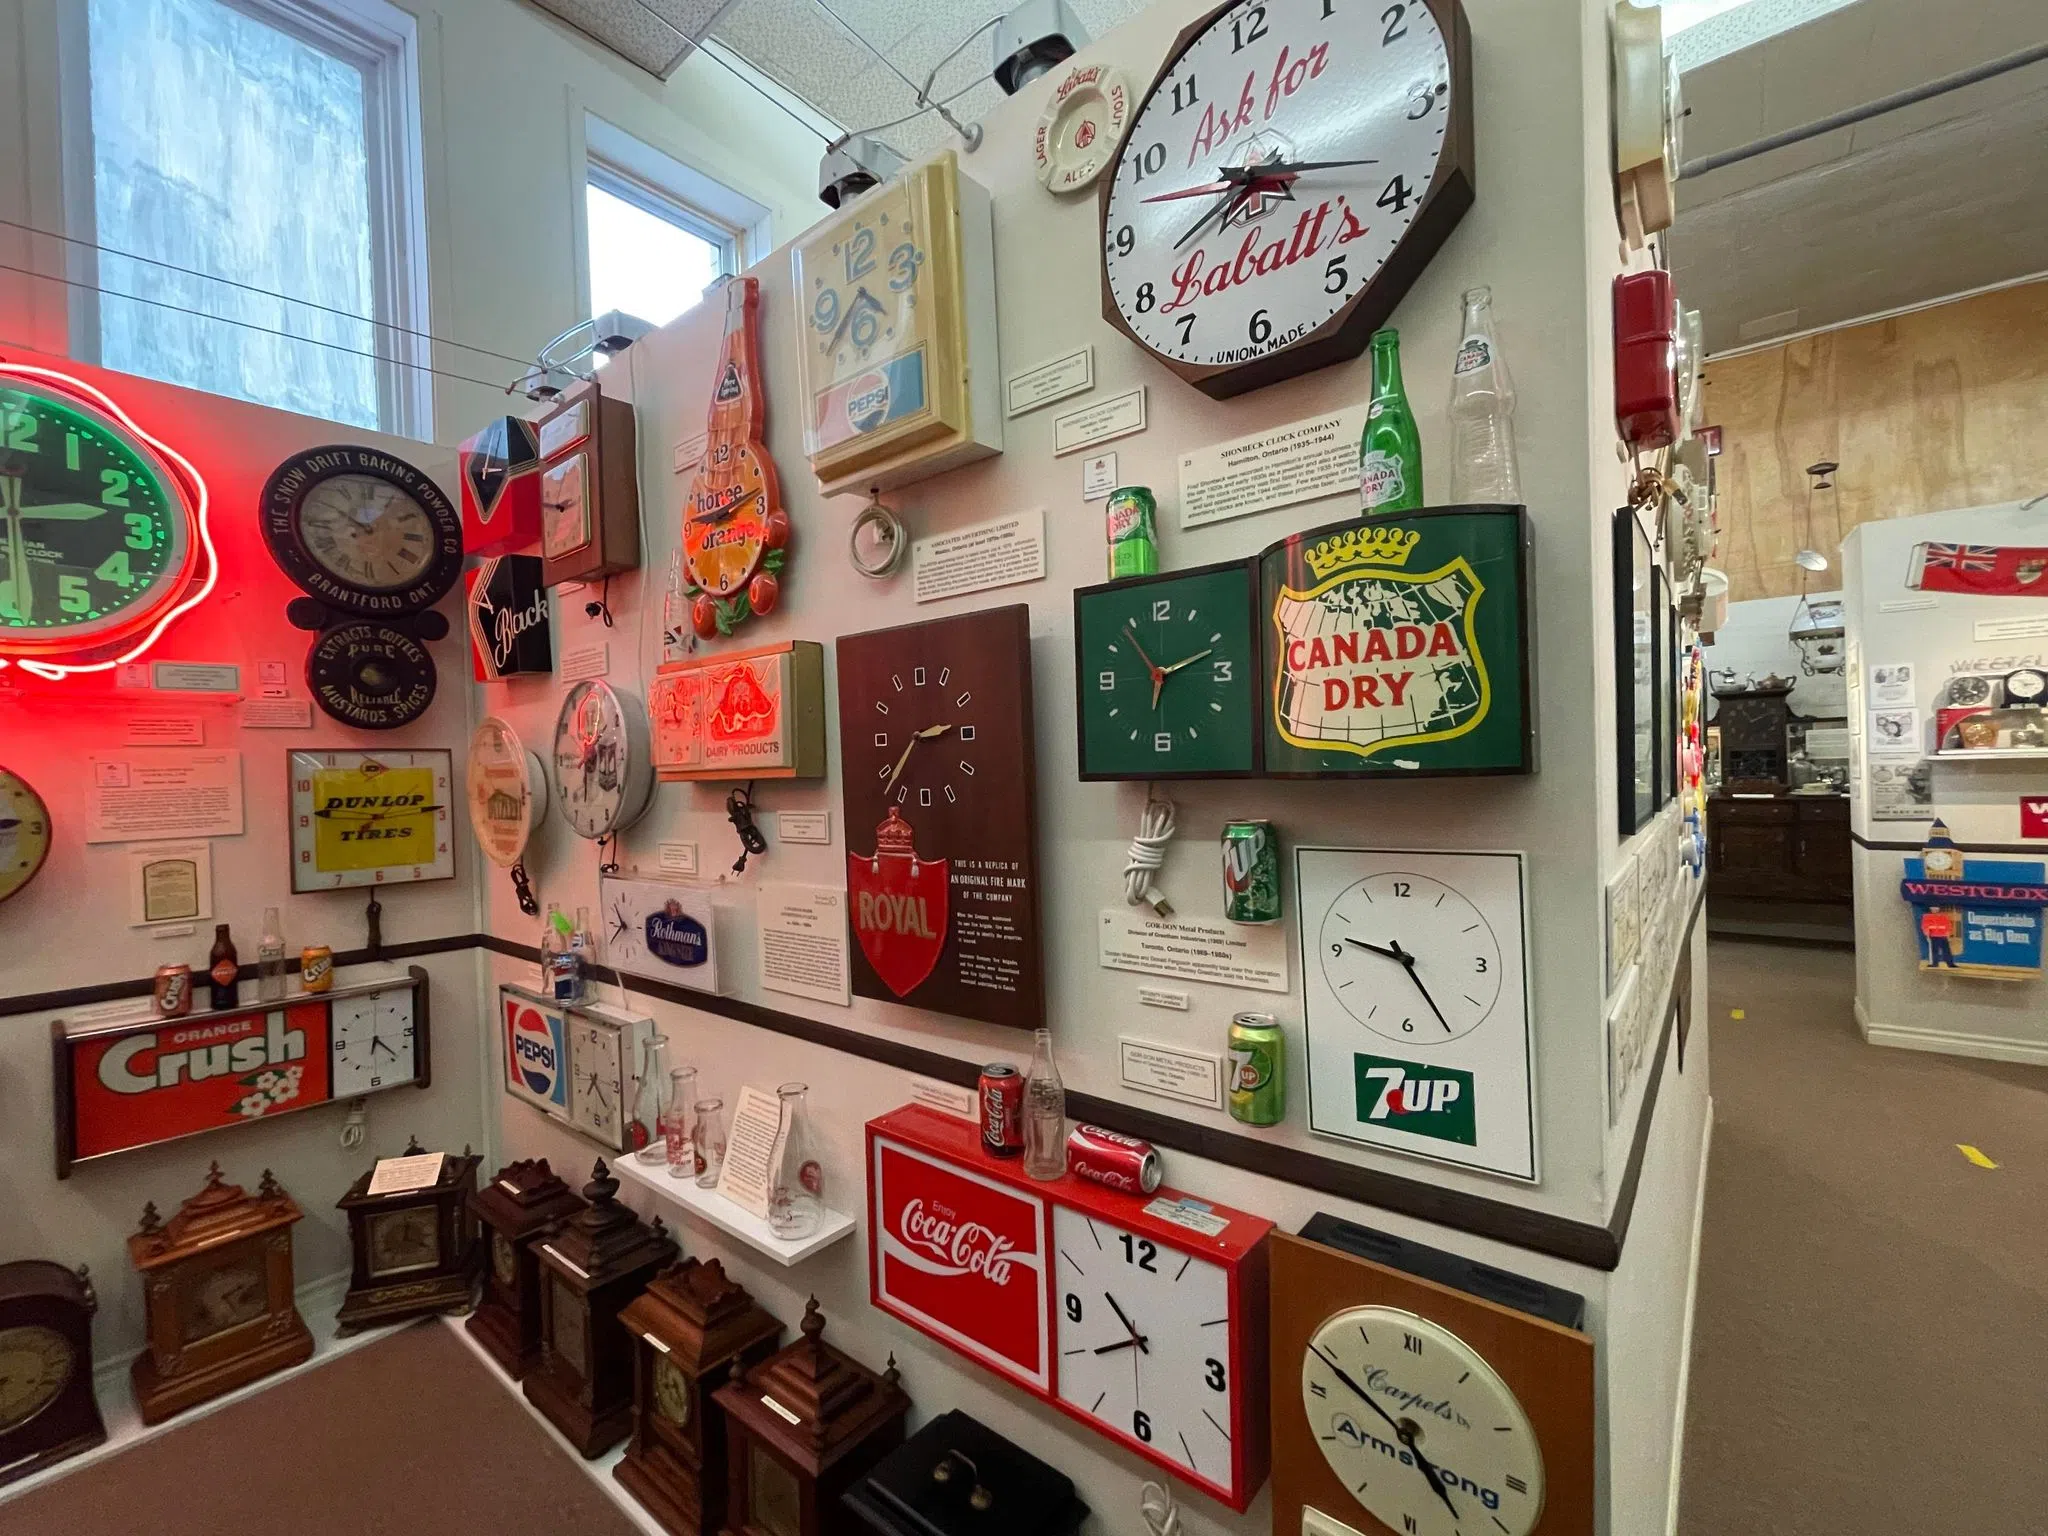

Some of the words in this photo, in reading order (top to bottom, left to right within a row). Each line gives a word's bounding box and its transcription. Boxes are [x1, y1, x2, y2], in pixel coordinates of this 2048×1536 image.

[1230, 7, 1270, 54] 12
[1381, 4, 1407, 47] 2
[1111, 85, 1124, 129] STOUT
[1171, 74, 1200, 116] 11
[1187, 70, 1256, 169] Ask
[1263, 41, 1330, 121] for
[1406, 80, 1435, 121] 3
[1036, 126, 1047, 169] LAGER
[1133, 142, 1167, 185] 10
[1064, 159, 1095, 184] ALES
[1376, 174, 1412, 214] 4
[842, 228, 876, 285] 12
[1116, 224, 1135, 257] 9
[1160, 195, 1369, 315] Labatt's
[888, 242, 917, 293] 3
[1324, 254, 1349, 294] 5
[815, 287, 840, 335] 9
[1136, 282, 1156, 314] 8
[851, 298, 878, 348] 6
[1175, 313, 1197, 346] 7
[1248, 309, 1272, 344] 6
[1216, 345, 1258, 365] UNION
[1267, 325, 1308, 353] MADE
[848, 386, 889, 417] PEPSI
[66, 433, 80, 471] 1
[714, 444, 729, 465] 12
[1221, 441, 1264, 459] SHONBECK
[1266, 432, 1296, 446] CLOCK
[1297, 419, 1342, 437] COMPANY
[1262, 446, 1288, 458] Ontario
[305, 451, 352, 474] DRIFT
[359, 453, 416, 484] BAKING
[101, 468, 129, 507] 2
[274, 467, 307, 504] SNOW
[1365, 481, 1385, 494] DRY
[416, 482, 455, 532] POWDER
[756, 495, 765, 515] 3
[124, 513, 152, 550] 3
[272, 509, 289, 535] THE
[684, 521, 692, 538] 9
[94, 551, 134, 587] 4
[720, 574, 728, 591] 6
[59, 575, 90, 613] 5
[308, 572, 402, 609] BRANTFORD
[1152, 601, 1171, 621] 12
[495, 588, 549, 668] Black
[379, 628, 424, 663] COFFEES
[1287, 621, 1460, 673] CANADA
[1100, 671, 1114, 691] 9
[1213, 662, 1232, 682] 3
[393, 683, 428, 719] SPICES
[1323, 671, 1416, 712] DRY
[706, 745, 728, 758] DAIRY
[732, 742, 779, 757] PRODUCTS
[1155, 733, 1172, 752] 6
[297, 780, 310, 792] 10
[439, 777, 446, 788] 2
[326, 795, 424, 809] DUNLOP
[300, 815, 309, 828] 9
[340, 827, 412, 841] TIRES
[301, 851, 310, 863] 8
[438, 843, 447, 853] 4
[954, 859, 966, 868] THIS
[978, 860, 982, 868] A
[985, 861, 1008, 870] REPLICA
[336, 874, 343, 886] 7
[376, 870, 384, 882] 6
[414, 867, 421, 878] 5
[951, 875, 959, 884] AN
[960, 875, 988, 886] ORIGINAL
[990, 876, 1003, 887] FIRE
[1007, 878, 1026, 888] MARK
[973, 892, 982, 900] THE
[986, 893, 1013, 903] COMPANY
[1393, 883, 1411, 898] 12
[1905, 883, 2048, 901] WESTCLOX
[650, 917, 702, 946] Rothmans
[858, 891, 937, 940] ROYAL
[1332, 943, 1342, 957] 9
[1476, 957, 1487, 973] 3
[174, 1020, 253, 1045] ORANGE
[1402, 1018, 1414, 1033] 6
[98, 1011, 305, 1093] Crush
[515, 1034, 555, 1071] PEPSI
[932, 1200, 957, 1221] Enjoy
[900, 1198, 1014, 1287] Coca-Cola
[1118, 1233, 1158, 1274] 12
[1065, 1293, 1083, 1323] 9
[1404, 1332, 1423, 1356] XII
[1205, 1357, 1226, 1393] 3
[1362, 1364, 1452, 1420] Carpets
[1133, 1409, 1152, 1443] 6
[1337, 1420, 1499, 1510] Armsong
[1403, 1513, 1416, 1535] VI
